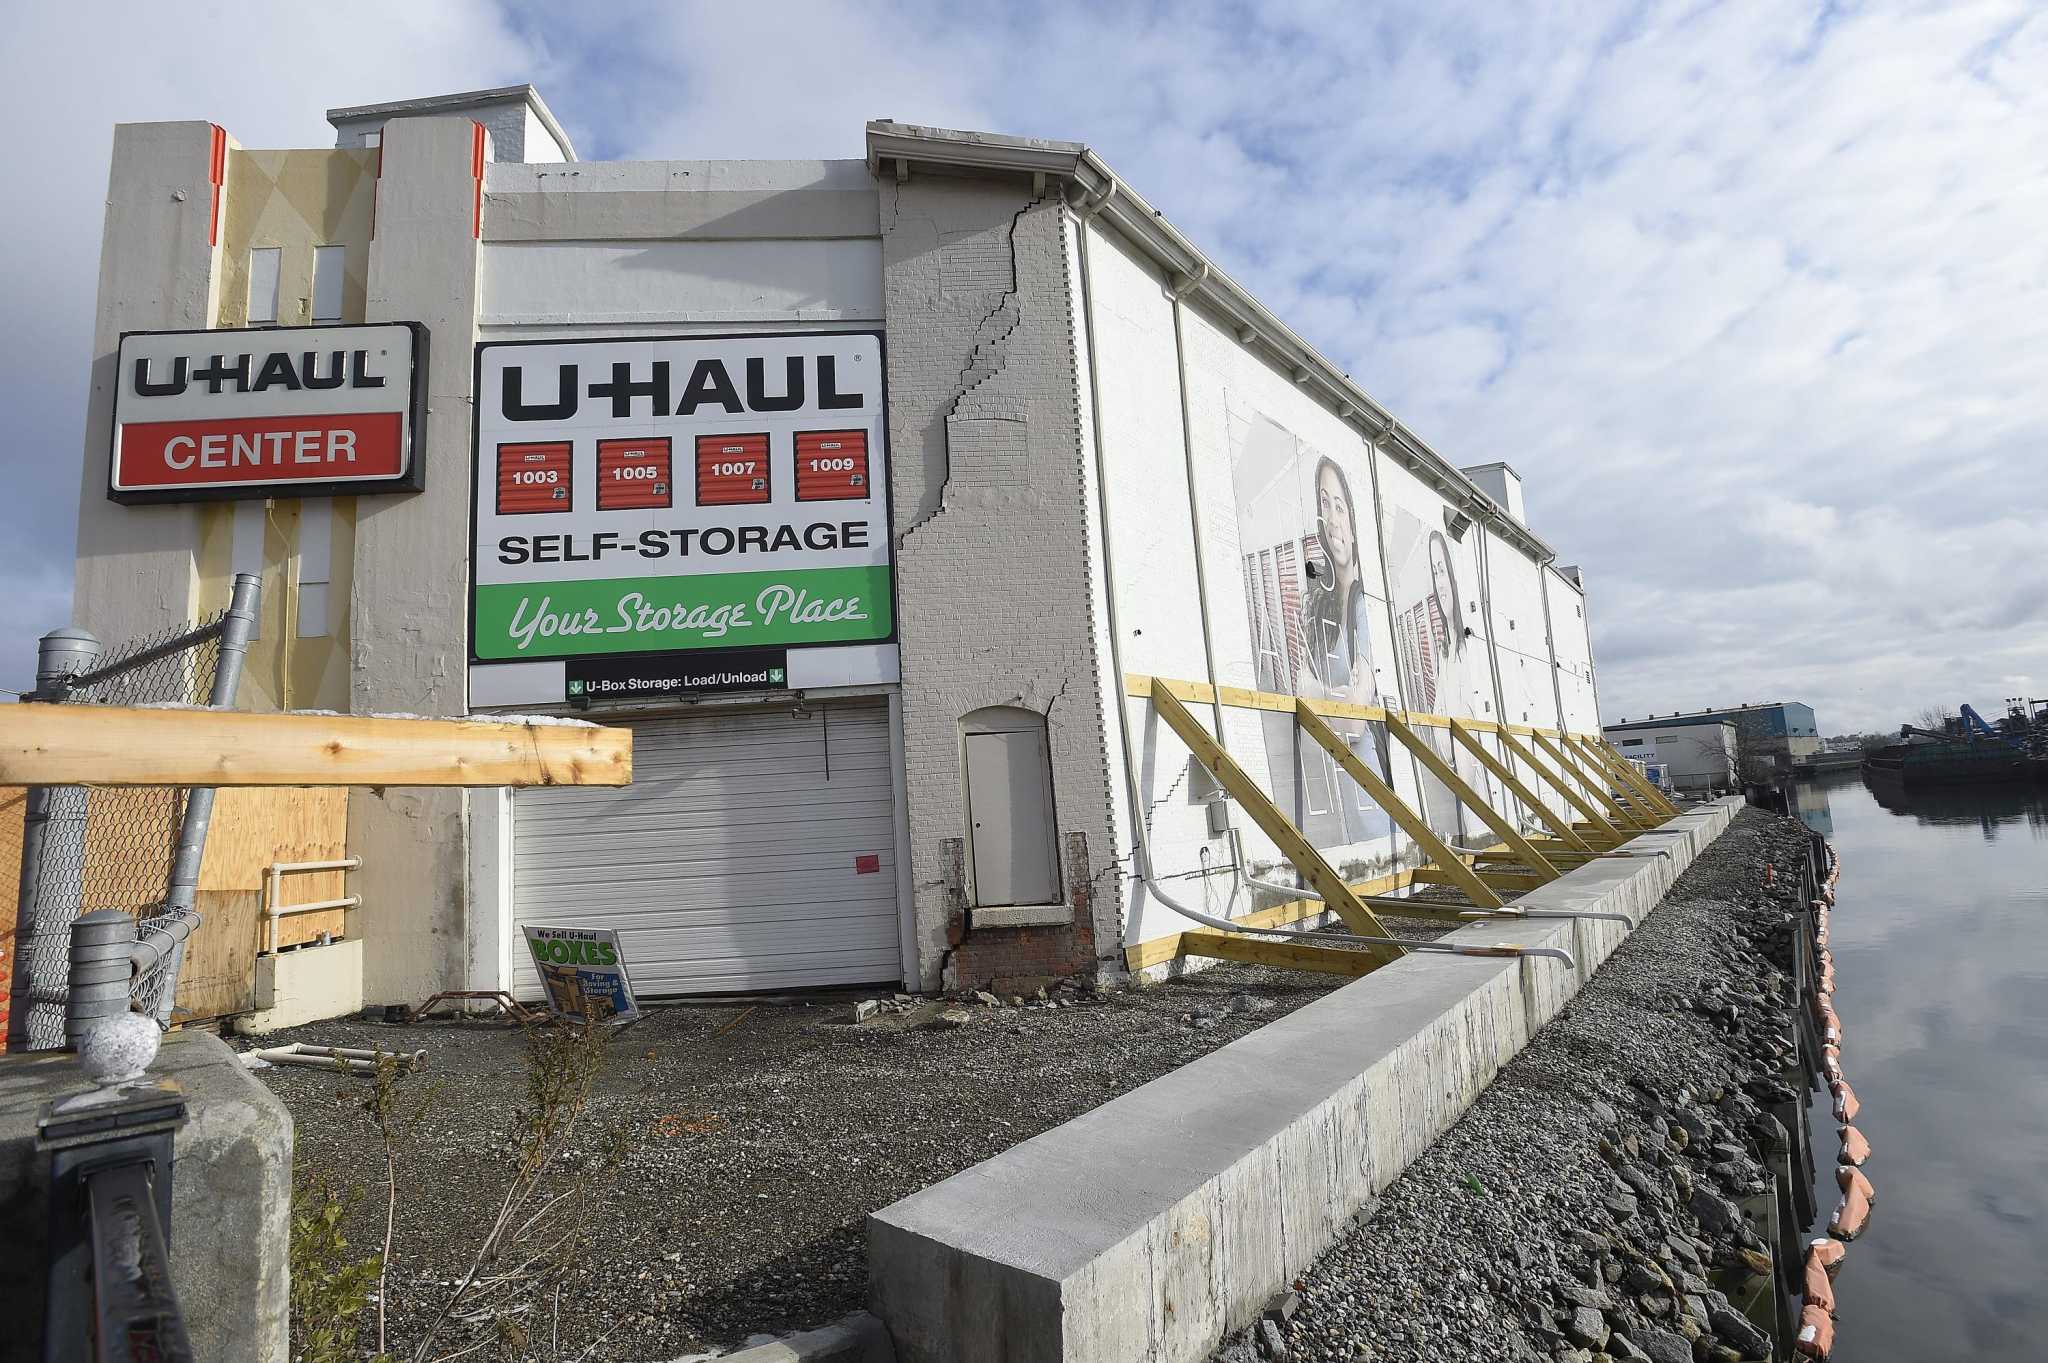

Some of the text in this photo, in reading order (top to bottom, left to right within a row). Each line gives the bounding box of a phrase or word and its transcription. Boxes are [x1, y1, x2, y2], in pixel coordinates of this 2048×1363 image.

[135, 350, 386, 396] U-HAUL
[502, 355, 863, 421] U-HAUL
[164, 429, 357, 470] CENTER
[613, 466, 658, 480] 1005
[712, 461, 755, 475] 1007
[810, 458, 854, 472] 1009
[513, 470, 558, 485] 1003
[498, 521, 869, 565] SELF-STORAGE
[508, 584, 868, 650] Your Storage Place
[586, 670, 767, 692] U-Box Storage: Load/Unload
[537, 929, 597, 941] We Sell U-Haul
[532, 939, 617, 966] BOXES
